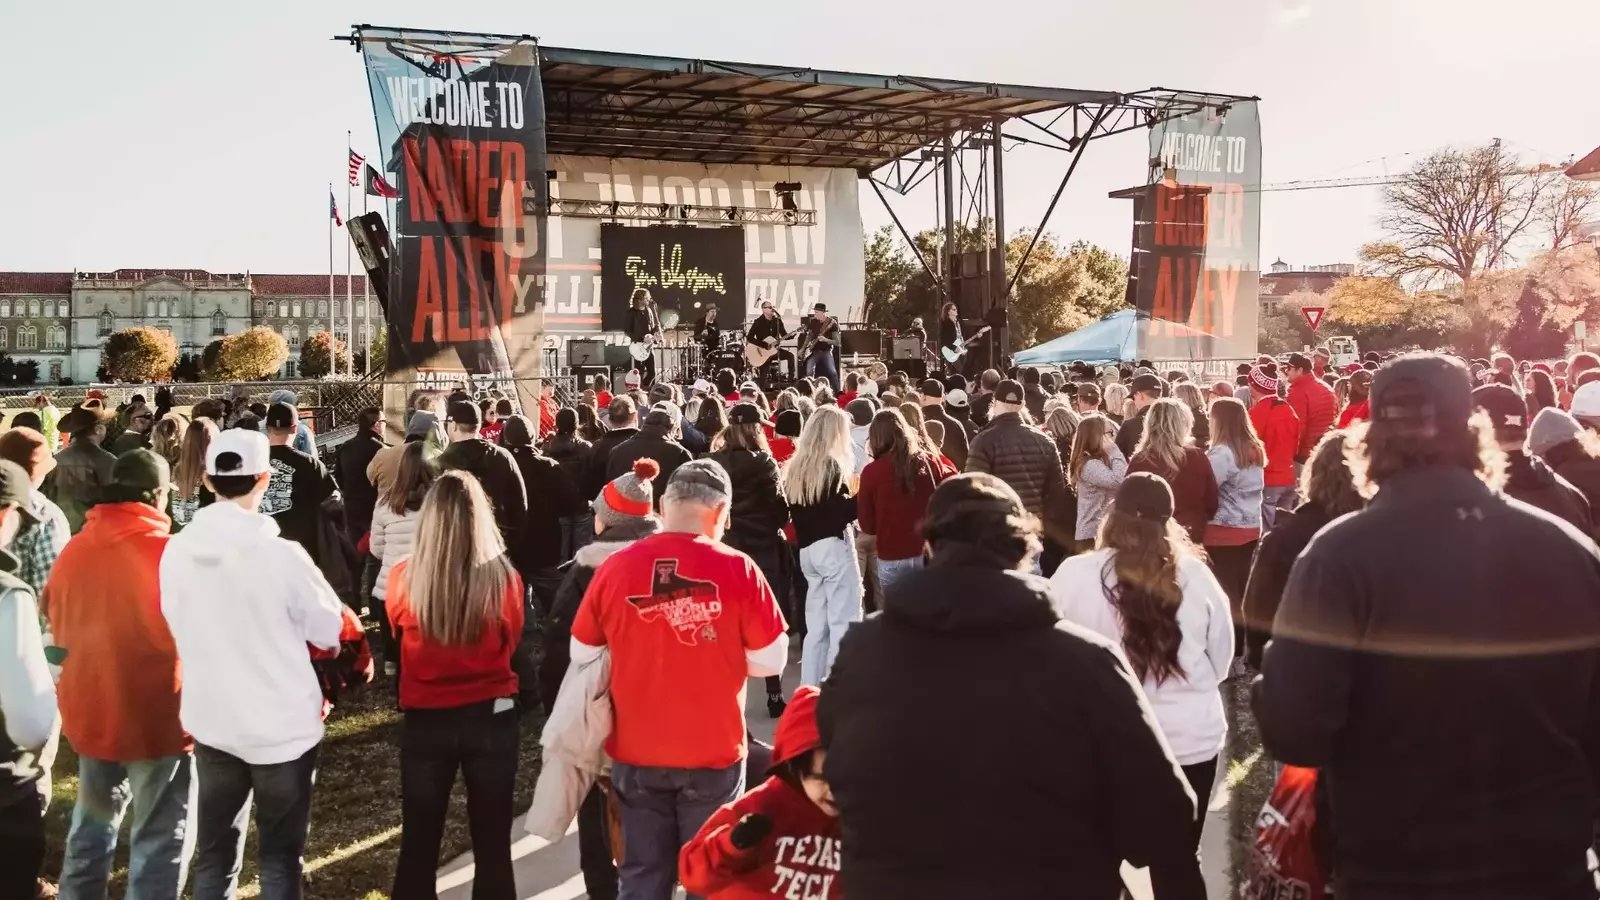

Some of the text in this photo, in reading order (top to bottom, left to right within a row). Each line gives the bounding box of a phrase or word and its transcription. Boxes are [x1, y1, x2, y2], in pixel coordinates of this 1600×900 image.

[386, 75, 525, 130] WELCOME TO
[1160, 132, 1247, 174] WELCOME TO
[664, 601, 721, 620] WORLD
